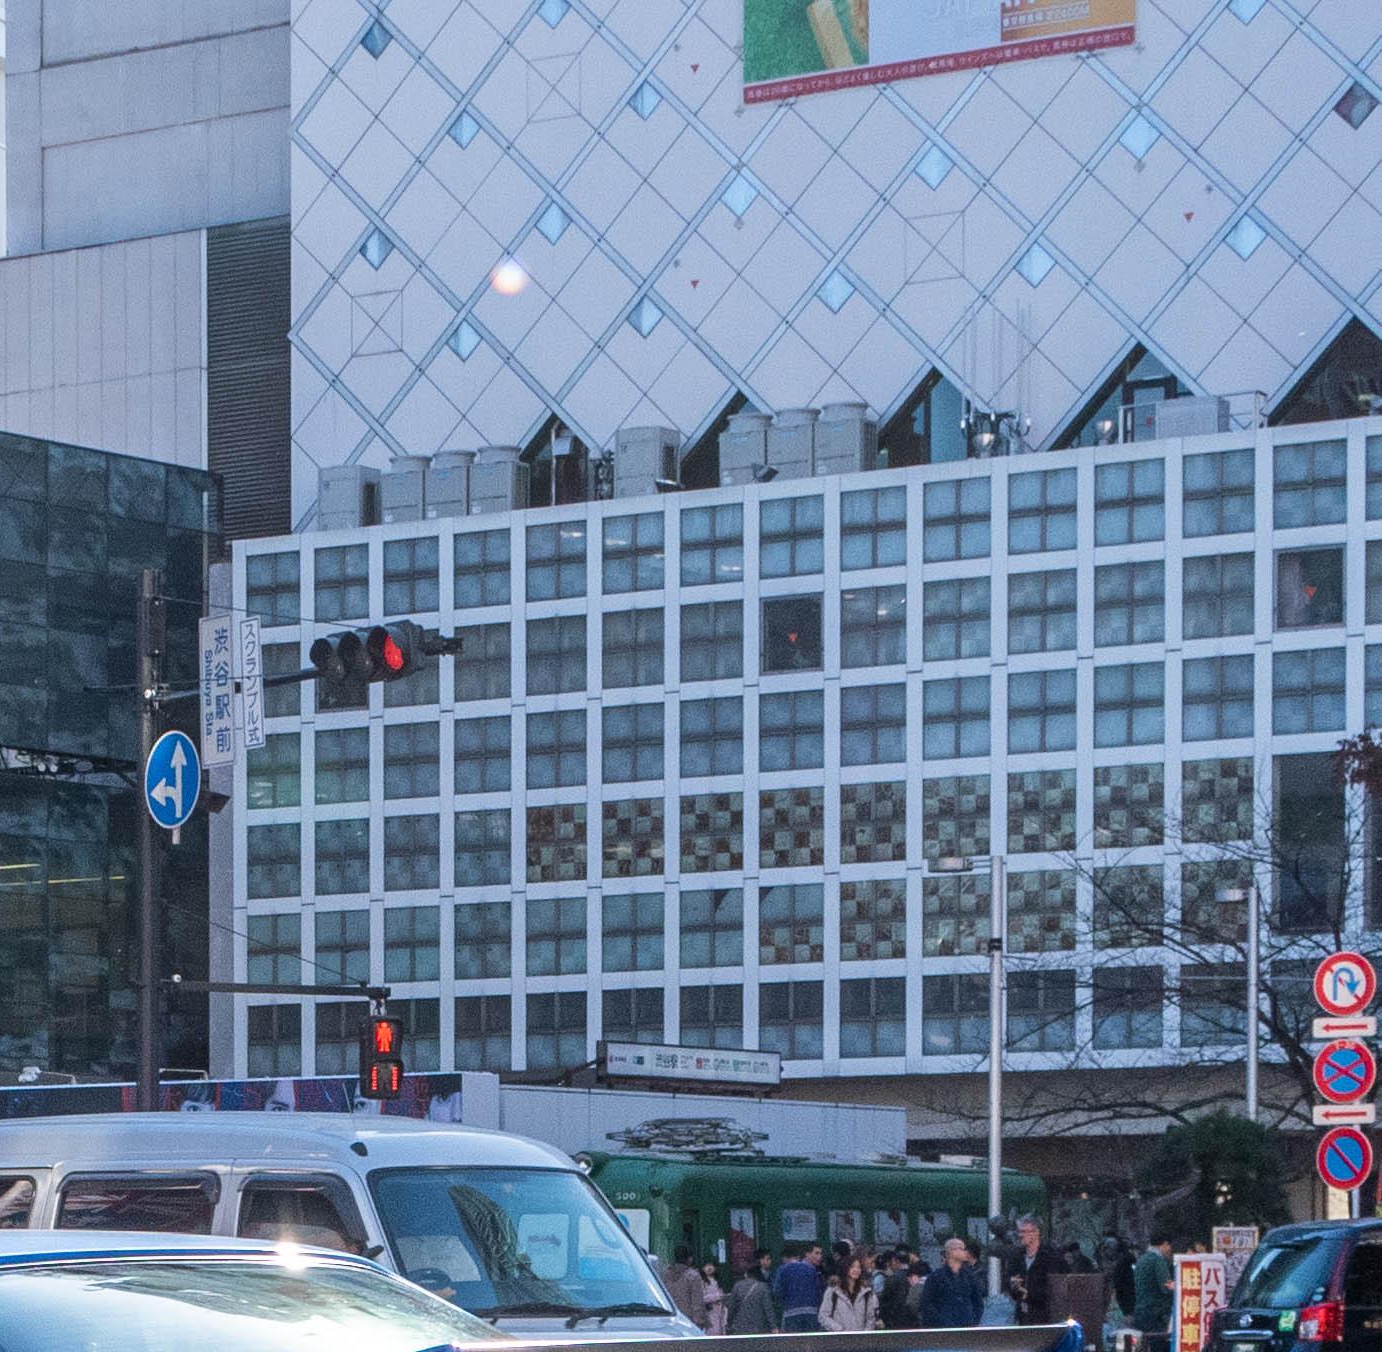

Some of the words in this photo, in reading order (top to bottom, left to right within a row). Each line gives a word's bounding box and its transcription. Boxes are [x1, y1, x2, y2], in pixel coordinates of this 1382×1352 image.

[204, 649, 213, 706] Shibuya
[214, 627, 231, 752] 渋谷駅前
[244, 623, 260, 743] スクランブル式
